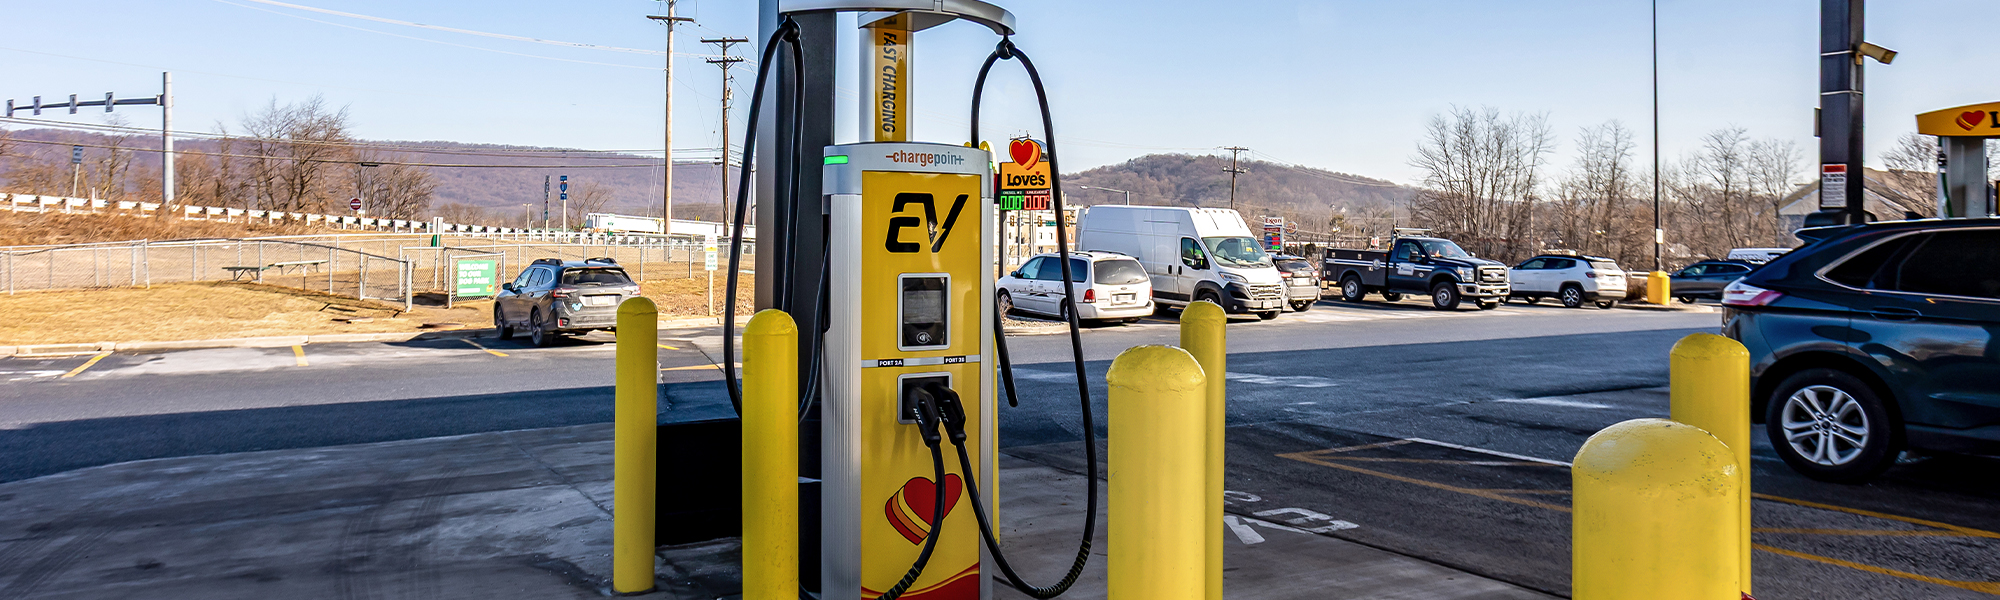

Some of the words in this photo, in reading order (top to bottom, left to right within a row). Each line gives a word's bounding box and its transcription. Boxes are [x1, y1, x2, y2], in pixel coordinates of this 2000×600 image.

[883, 31, 897, 63] FAST
[882, 65, 897, 133] CHARGING
[885, 192, 969, 252] EV
